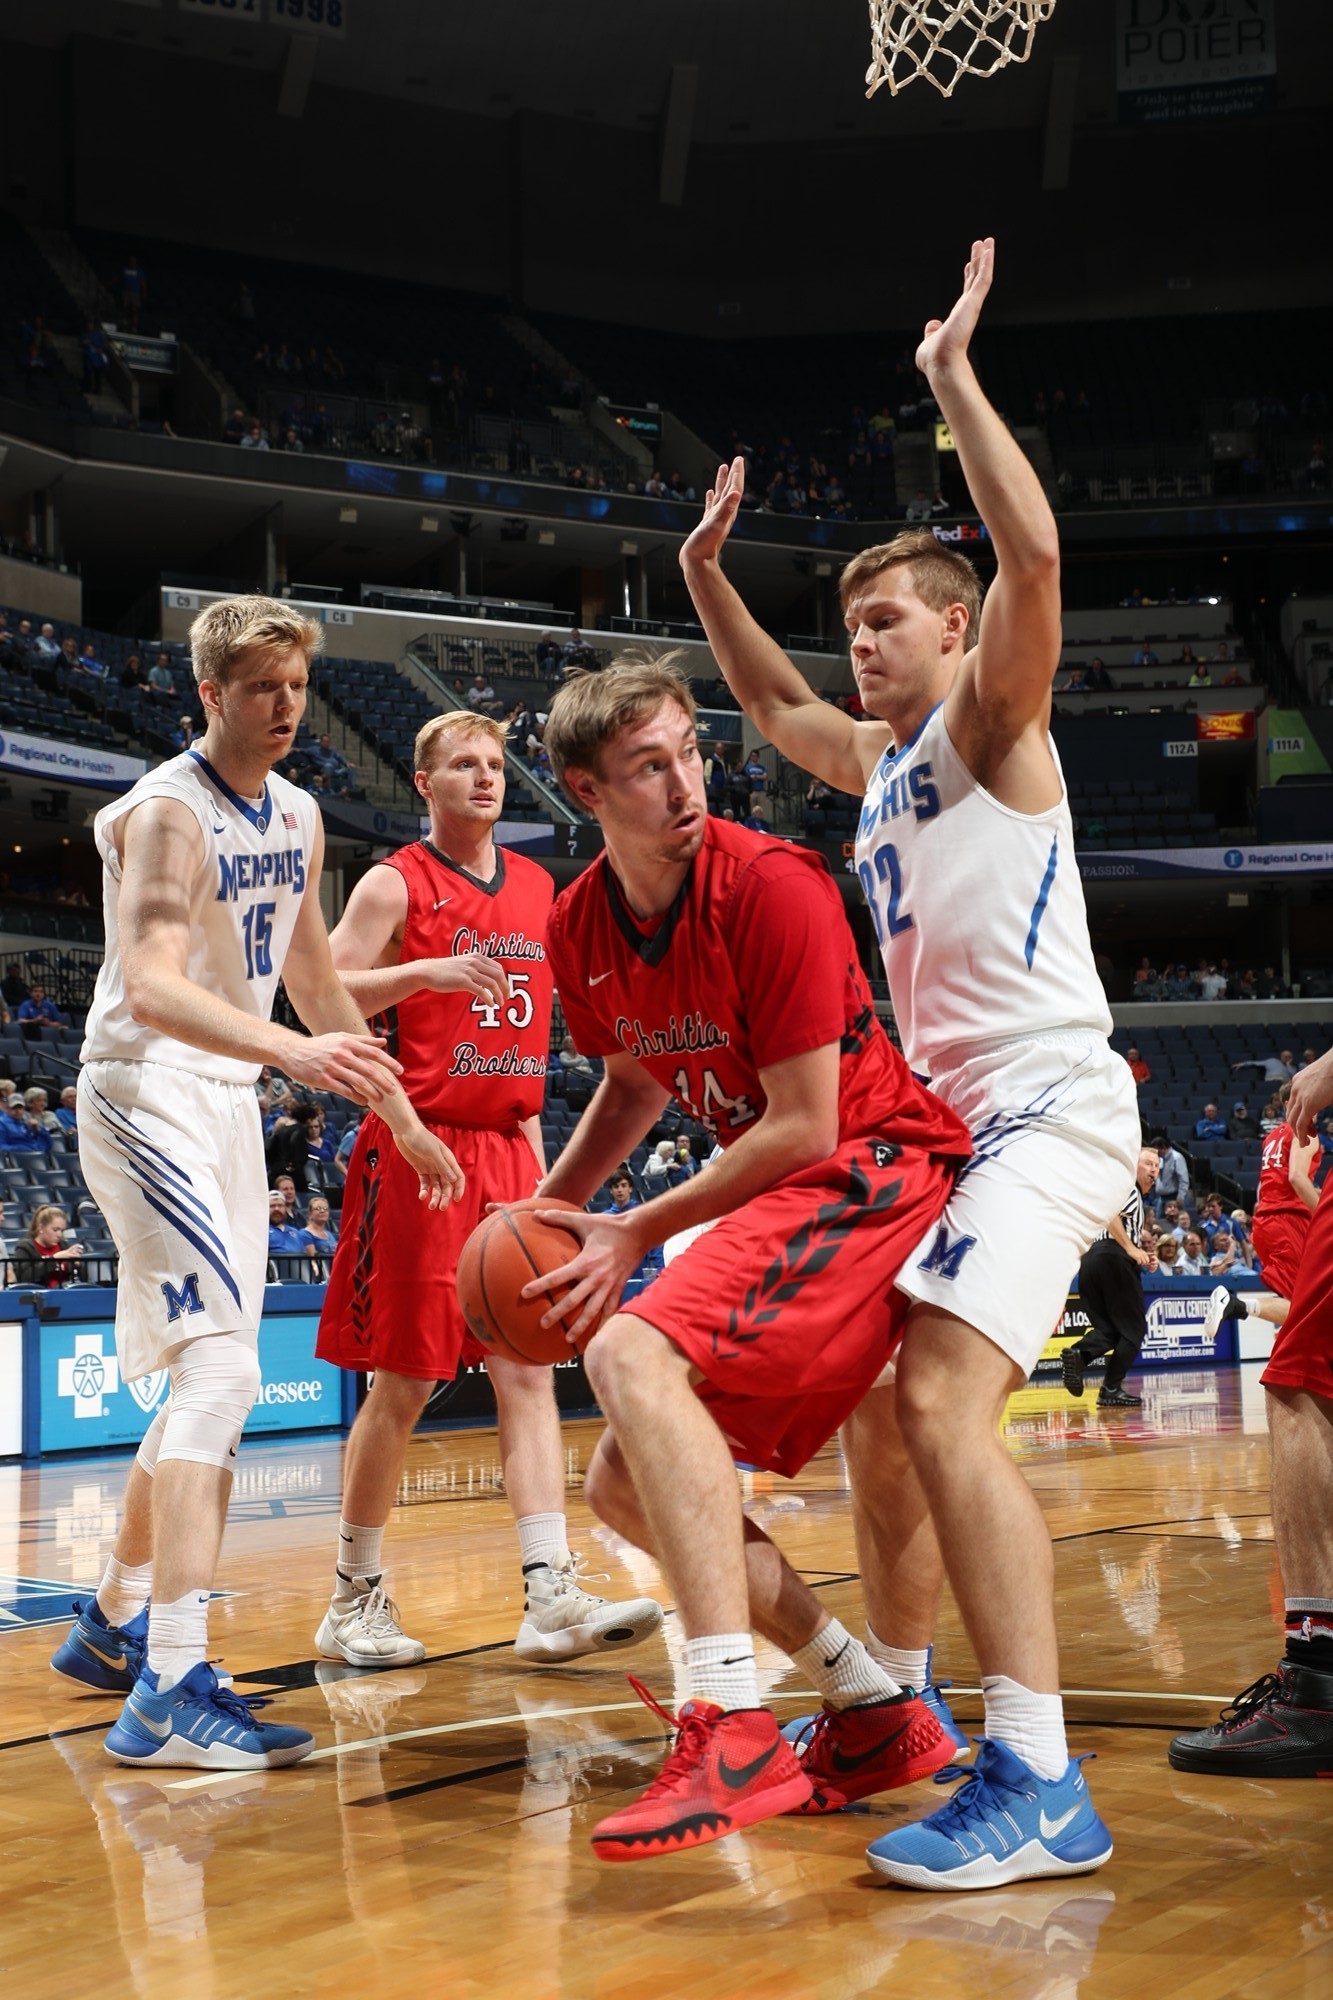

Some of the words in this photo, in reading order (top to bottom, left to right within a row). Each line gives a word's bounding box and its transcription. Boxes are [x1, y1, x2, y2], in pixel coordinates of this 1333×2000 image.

[176, 596, 191, 607] C9
[332, 612, 347, 623] C8
[10, 743, 57, 763] Regional
[59, 753, 80, 768] One
[82, 758, 115, 774] Health
[1168, 743, 1196, 755] 112A
[1276, 739, 1302, 751] 111A
[1248, 852, 1299, 865] Regional
[1300, 852, 1323, 863] One
[214, 848, 305, 903] MEMPHIS
[242, 902, 277, 981] 15
[470, 971, 535, 1030] 45
[448, 1041, 547, 1078] Brothers
[672, 1066, 758, 1132] 14
[1262, 1136, 1285, 1171] 44
[917, 1227, 978, 1281] M
[160, 1272, 205, 1323] M
[1164, 1299, 1186, 1319] TRUCK
[1141, 1346, 1215, 1360] www.tagtruckcenter.com
